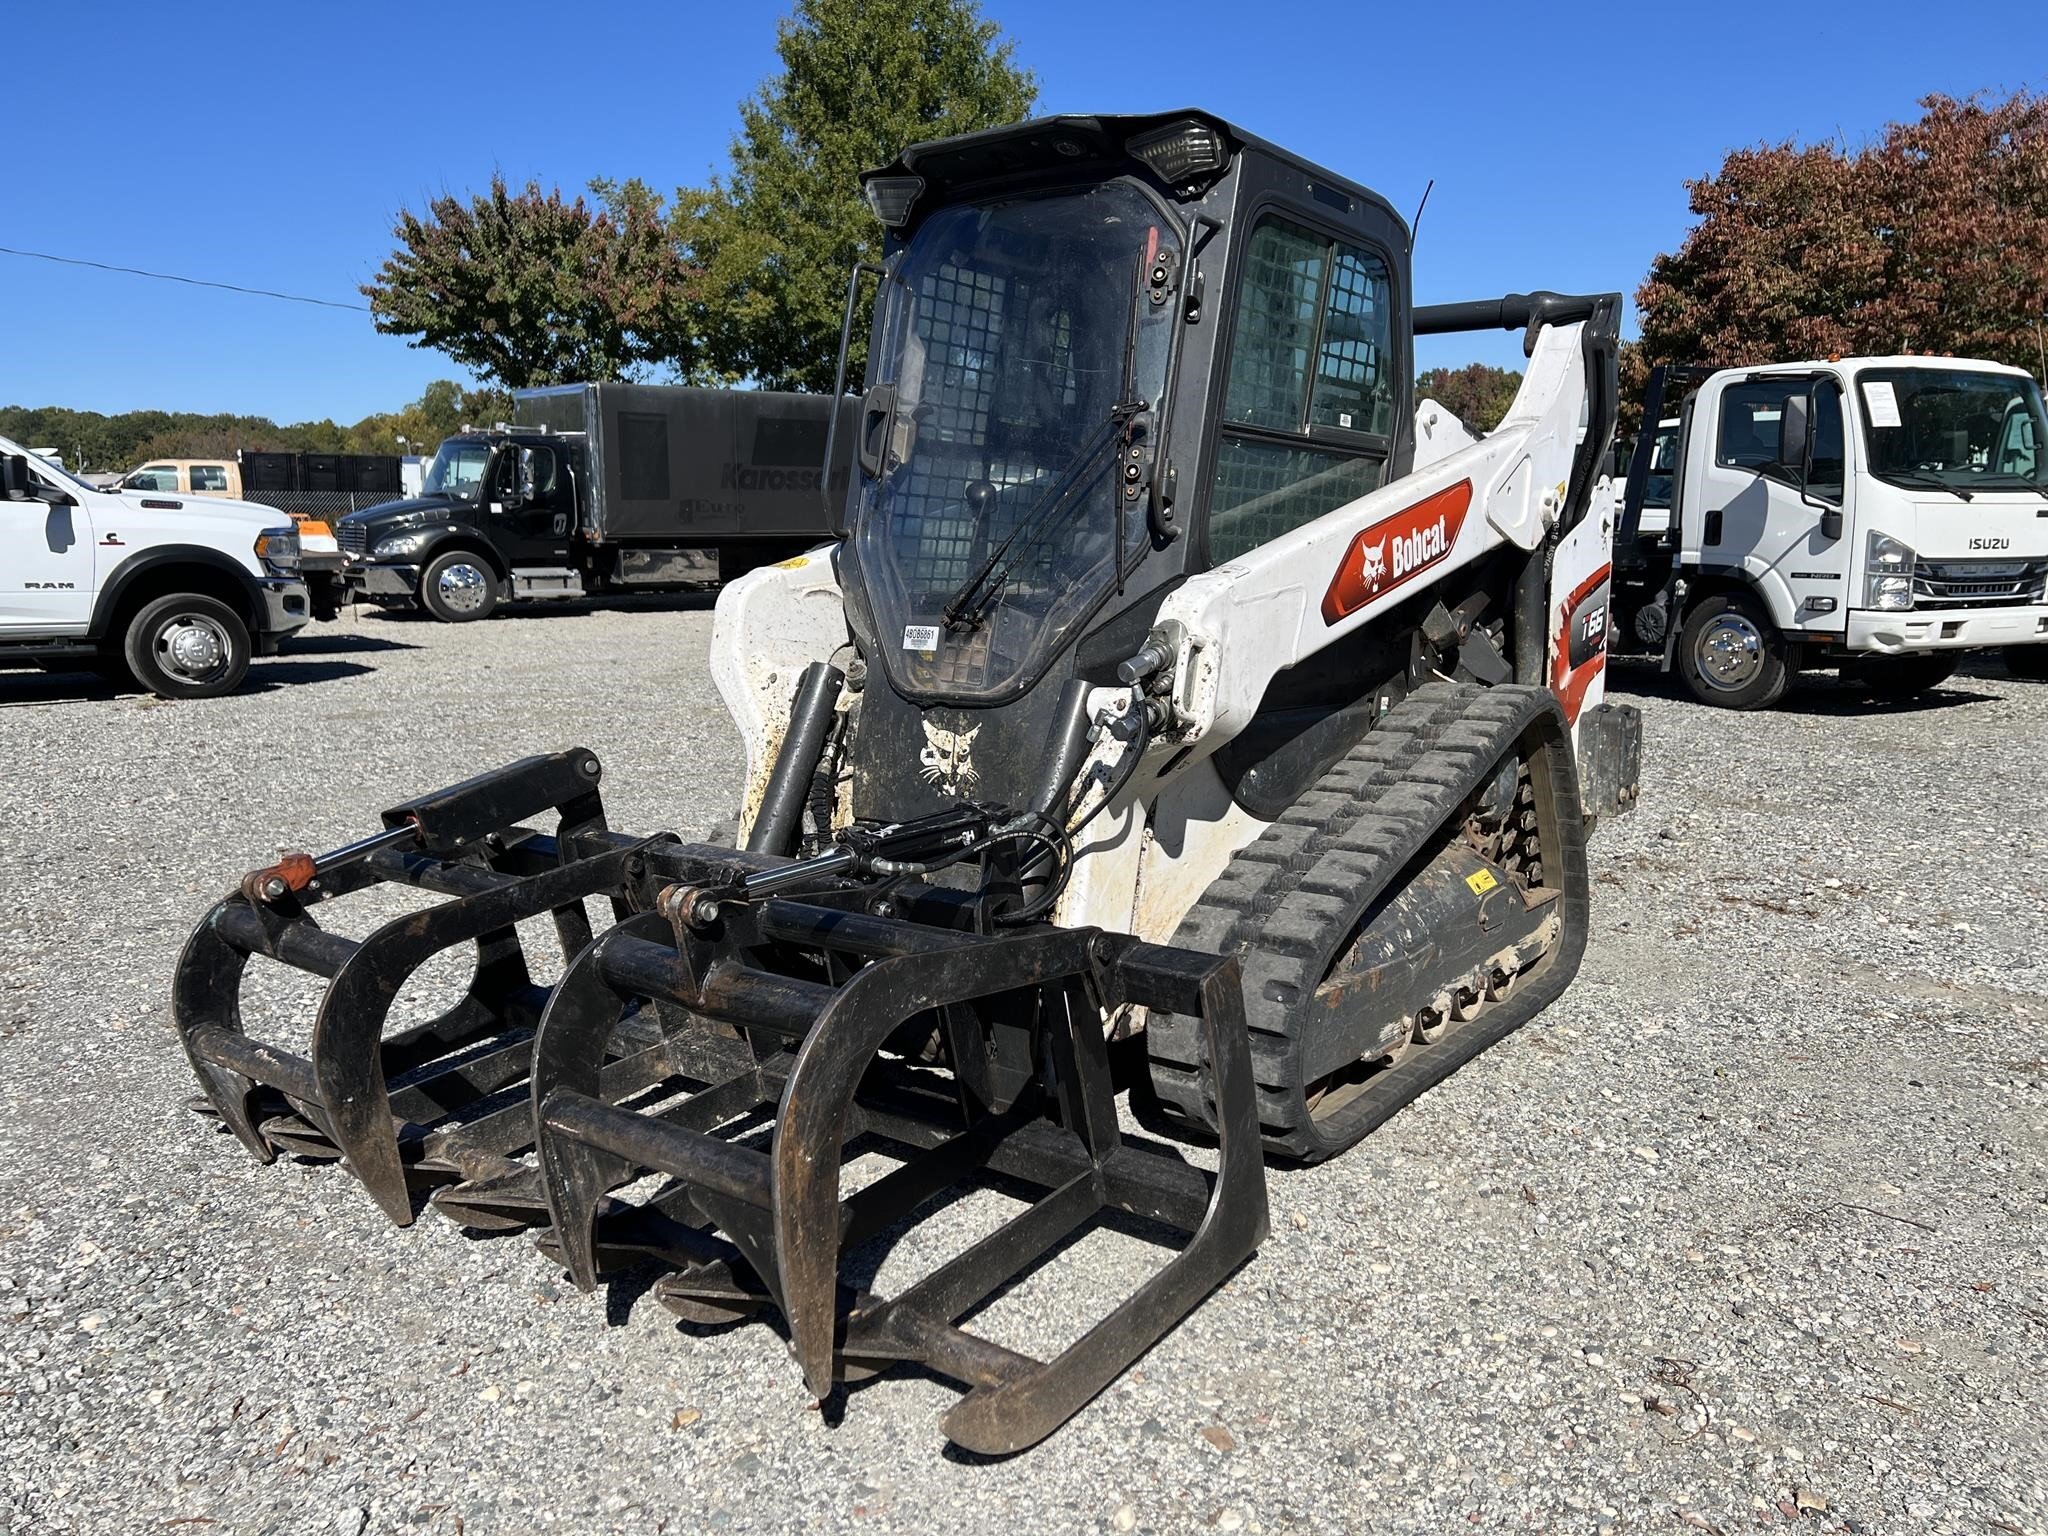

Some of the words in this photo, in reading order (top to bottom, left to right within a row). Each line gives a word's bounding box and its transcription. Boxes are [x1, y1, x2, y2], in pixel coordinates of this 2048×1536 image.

[1392, 514, 1446, 579] Bobcat
[1968, 538, 2010, 550] ISUZU
[1582, 606, 1605, 641] T66
